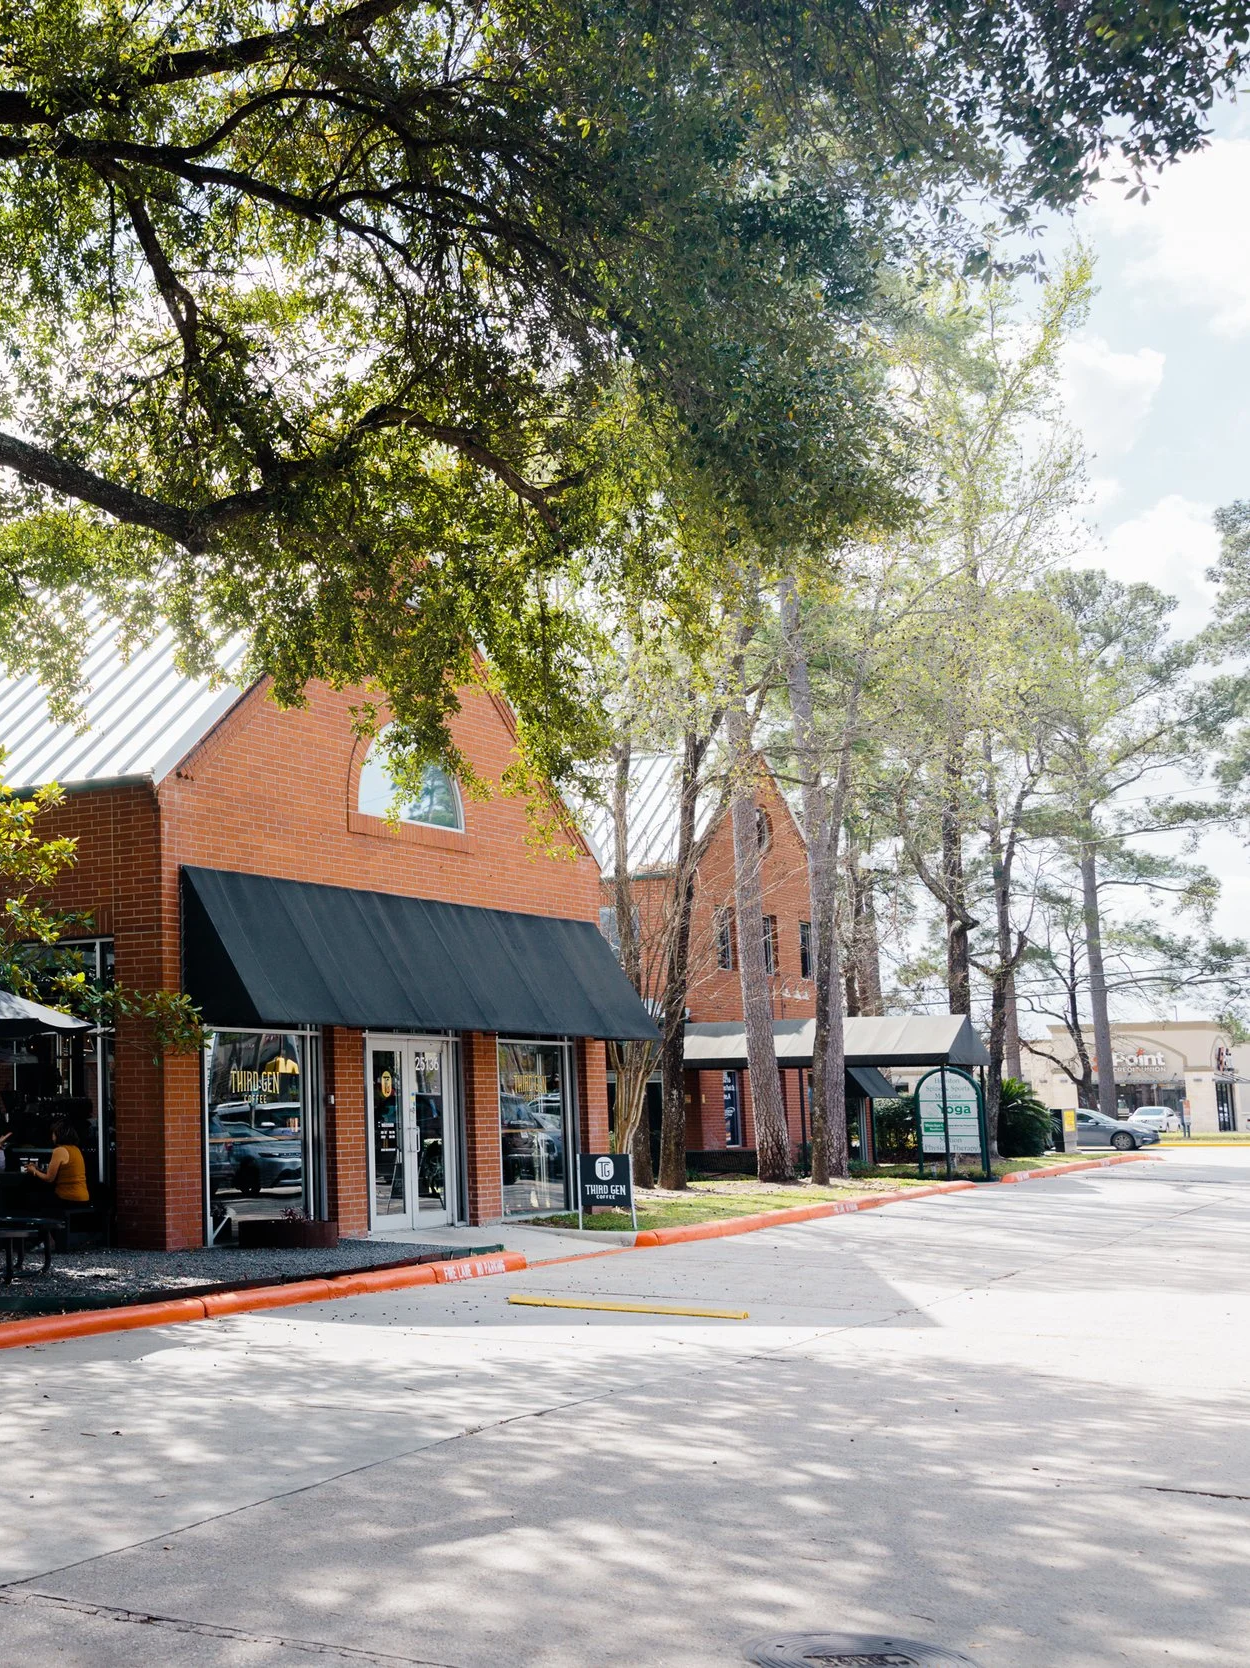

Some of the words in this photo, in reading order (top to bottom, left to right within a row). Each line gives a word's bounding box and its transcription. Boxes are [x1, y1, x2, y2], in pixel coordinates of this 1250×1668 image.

[415, 1057, 439, 1070] 25136
[230, 1071, 258, 1093] THIRD
[261, 1071, 280, 1094] GEN
[244, 1094, 267, 1104] COFFEE
[584, 1184, 609, 1195] THIRD
[610, 1184, 626, 1196] GEN
